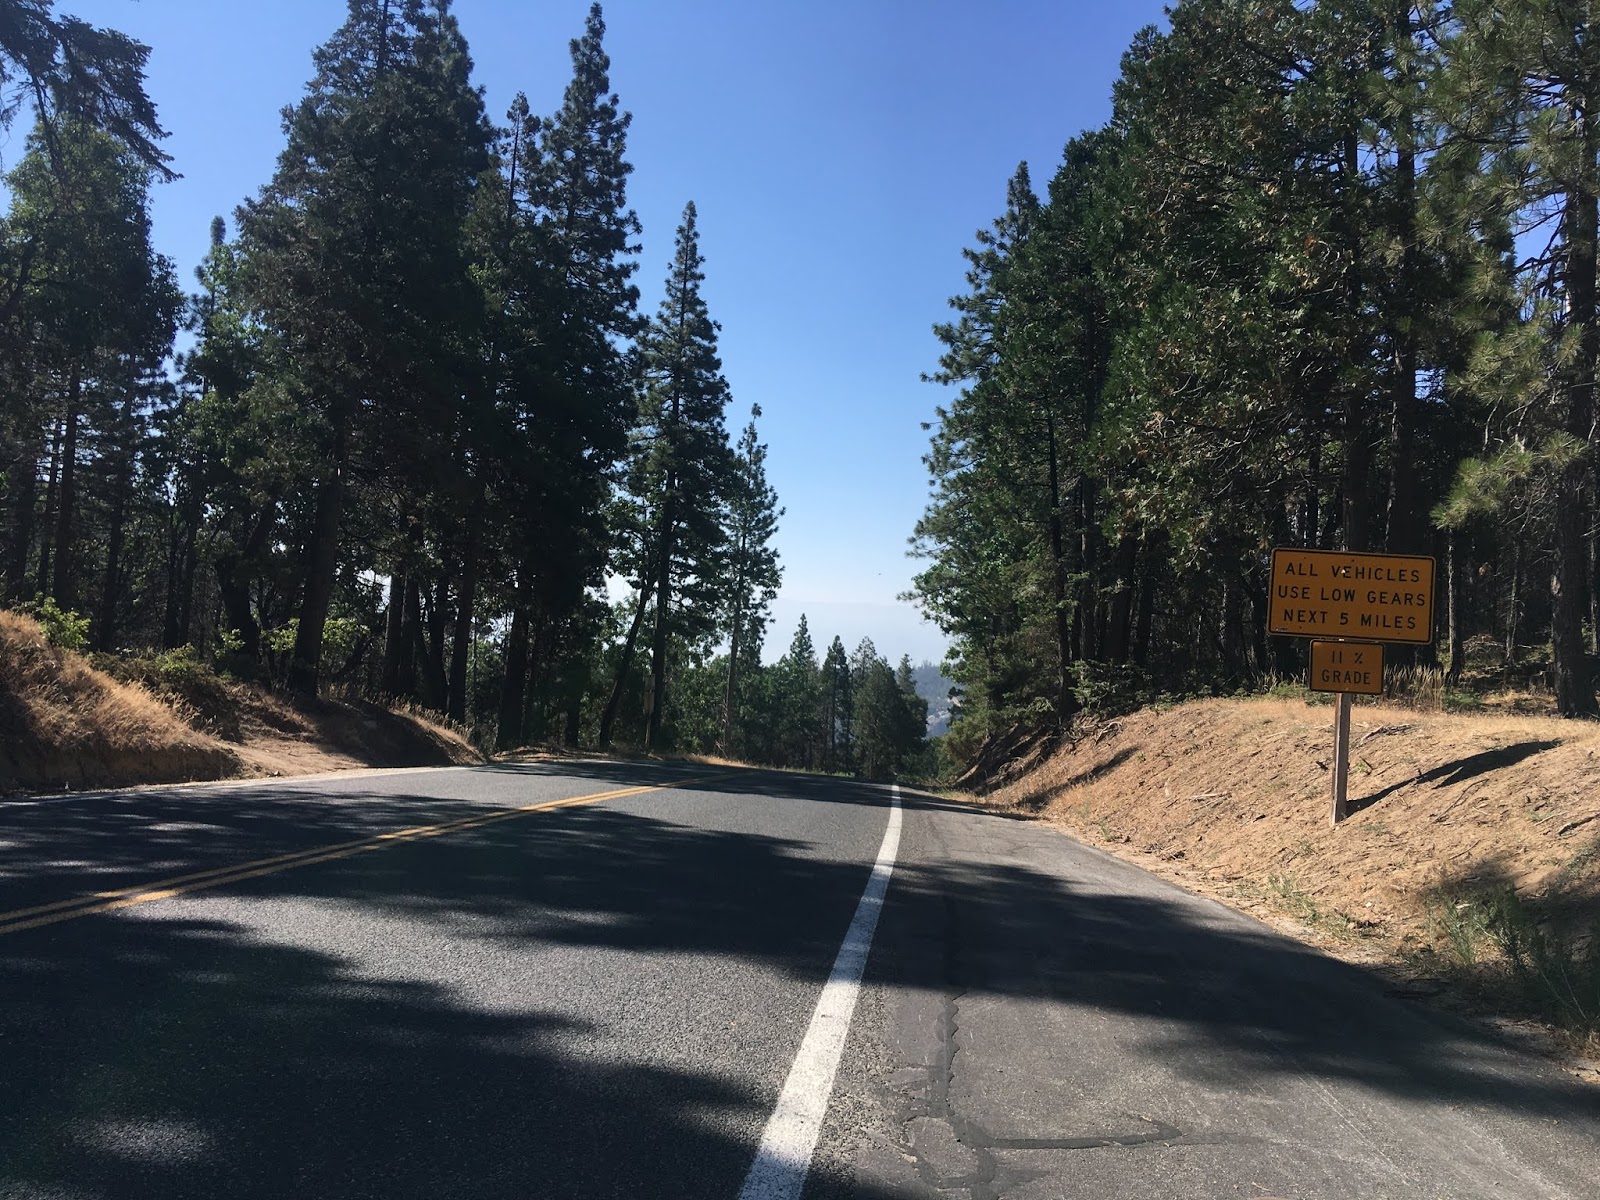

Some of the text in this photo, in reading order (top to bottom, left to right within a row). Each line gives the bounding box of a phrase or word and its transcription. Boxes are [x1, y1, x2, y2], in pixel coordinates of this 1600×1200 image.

[1285, 562, 1420, 583] ALL VEHICLES
[1278, 585, 1426, 606] USE LOW GEARS
[1283, 608, 1416, 630] NEXT 5 MILES
[1321, 669, 1371, 685] GRADE
